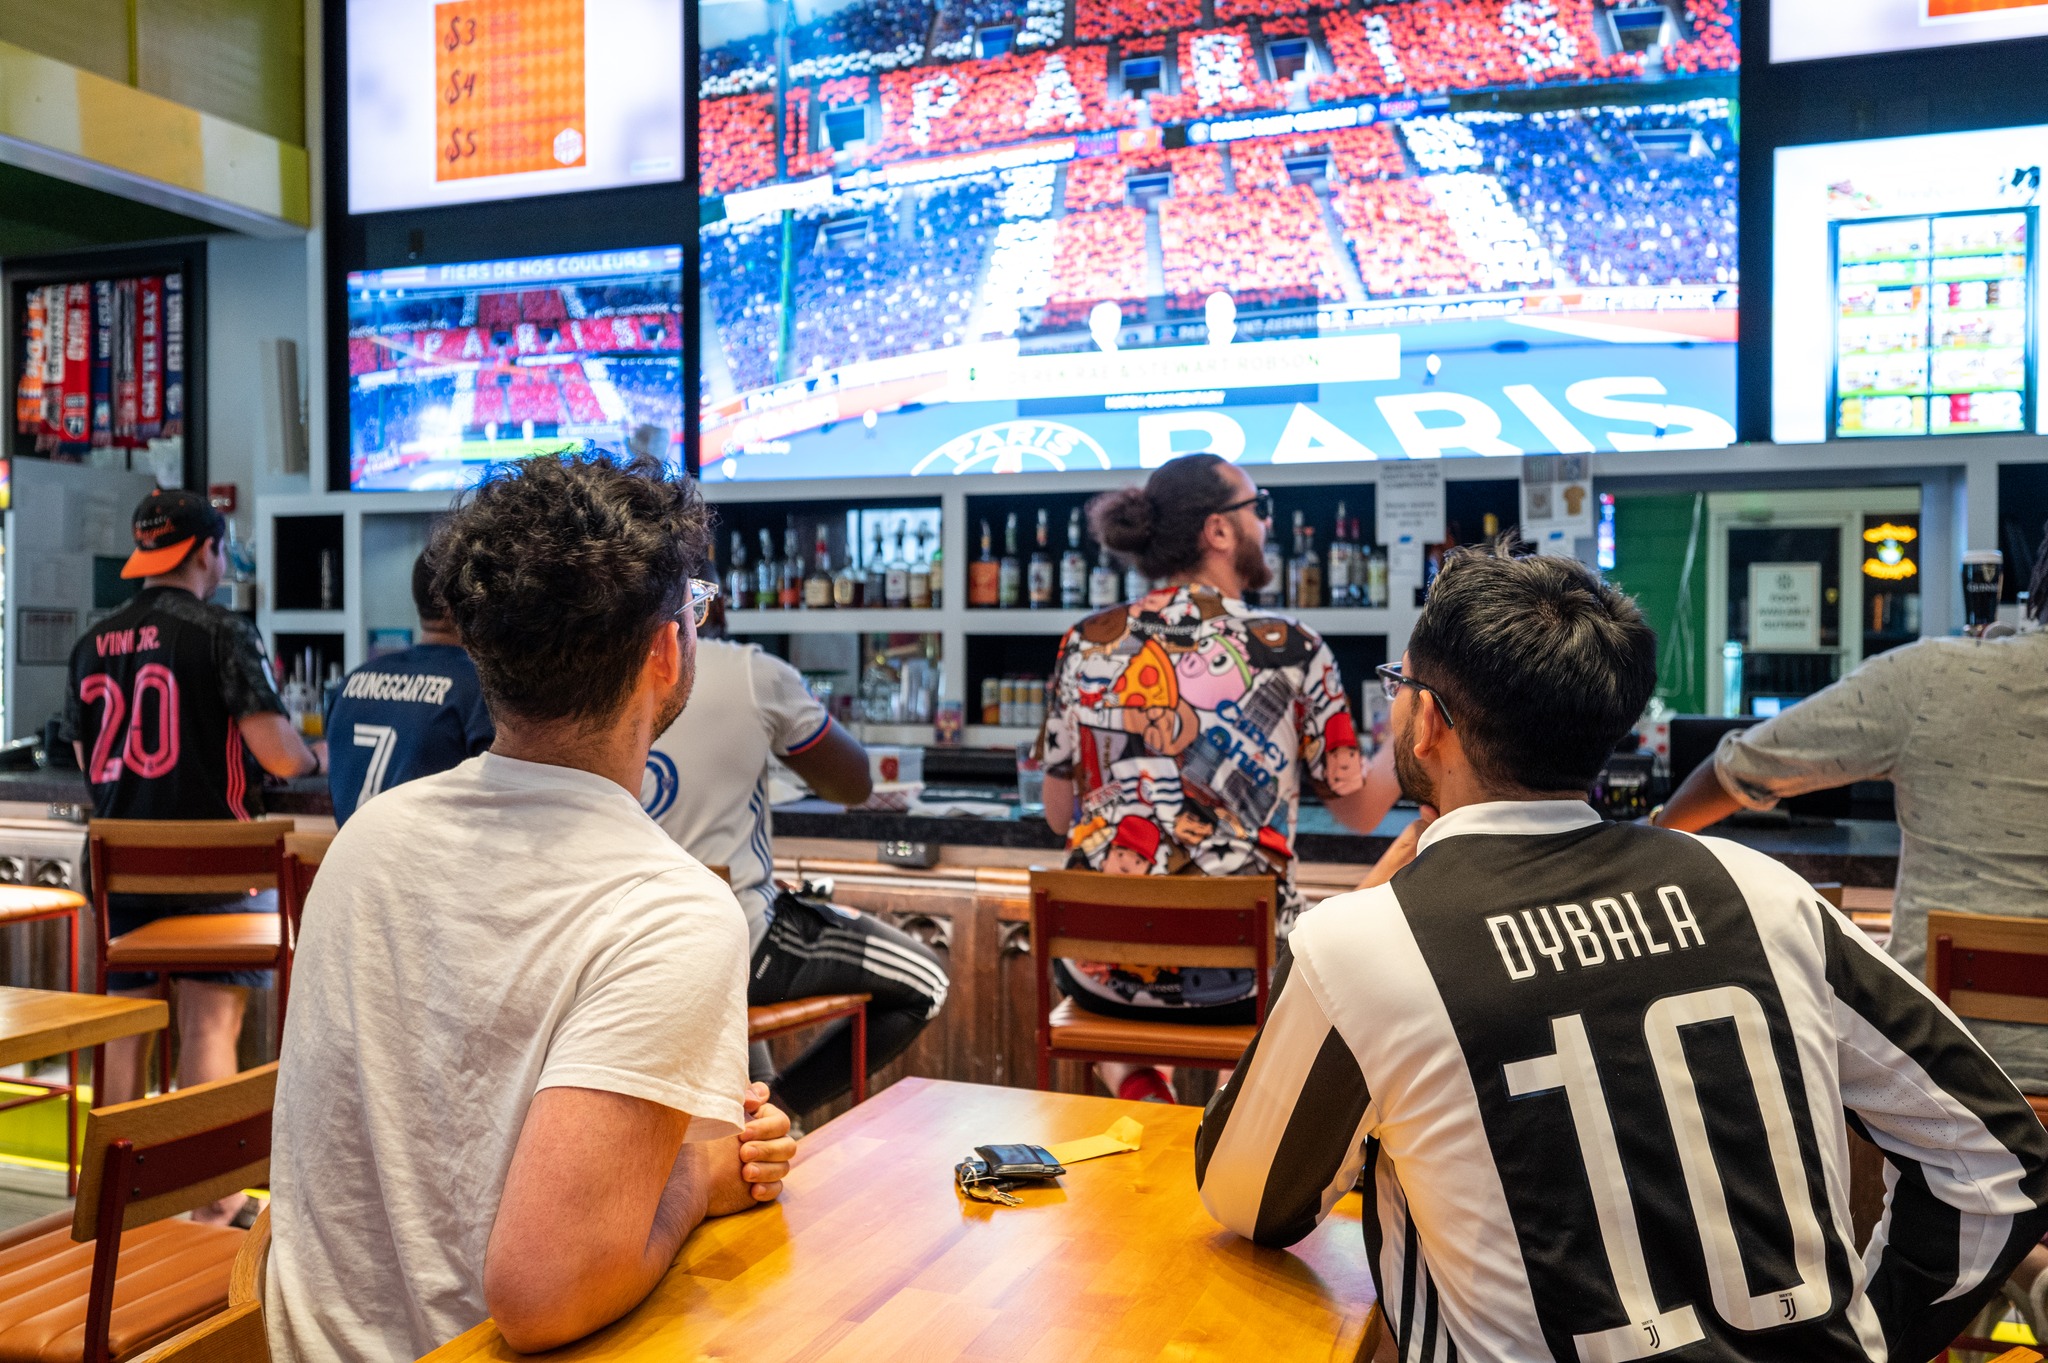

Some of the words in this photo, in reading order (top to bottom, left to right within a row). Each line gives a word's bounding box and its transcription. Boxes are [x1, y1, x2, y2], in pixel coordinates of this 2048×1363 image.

[445, 15, 476, 52] $3
[445, 69, 476, 105] $4
[445, 127, 476, 163] $5
[440, 263, 489, 281] FIERS
[493, 261, 515, 279] DE
[517, 259, 554, 277] NOS
[557, 252, 650, 275] COULEURS
[1138, 377, 1737, 469] PARIS
[945, 424, 1079, 464] PARIS
[95, 632, 133, 658] VINI
[136, 625, 160, 651] JR.
[80, 663, 180, 784] 20
[353, 723, 397, 812] 7
[1486, 885, 1707, 980] DYBALA
[1503, 986, 1832, 1363] 10
